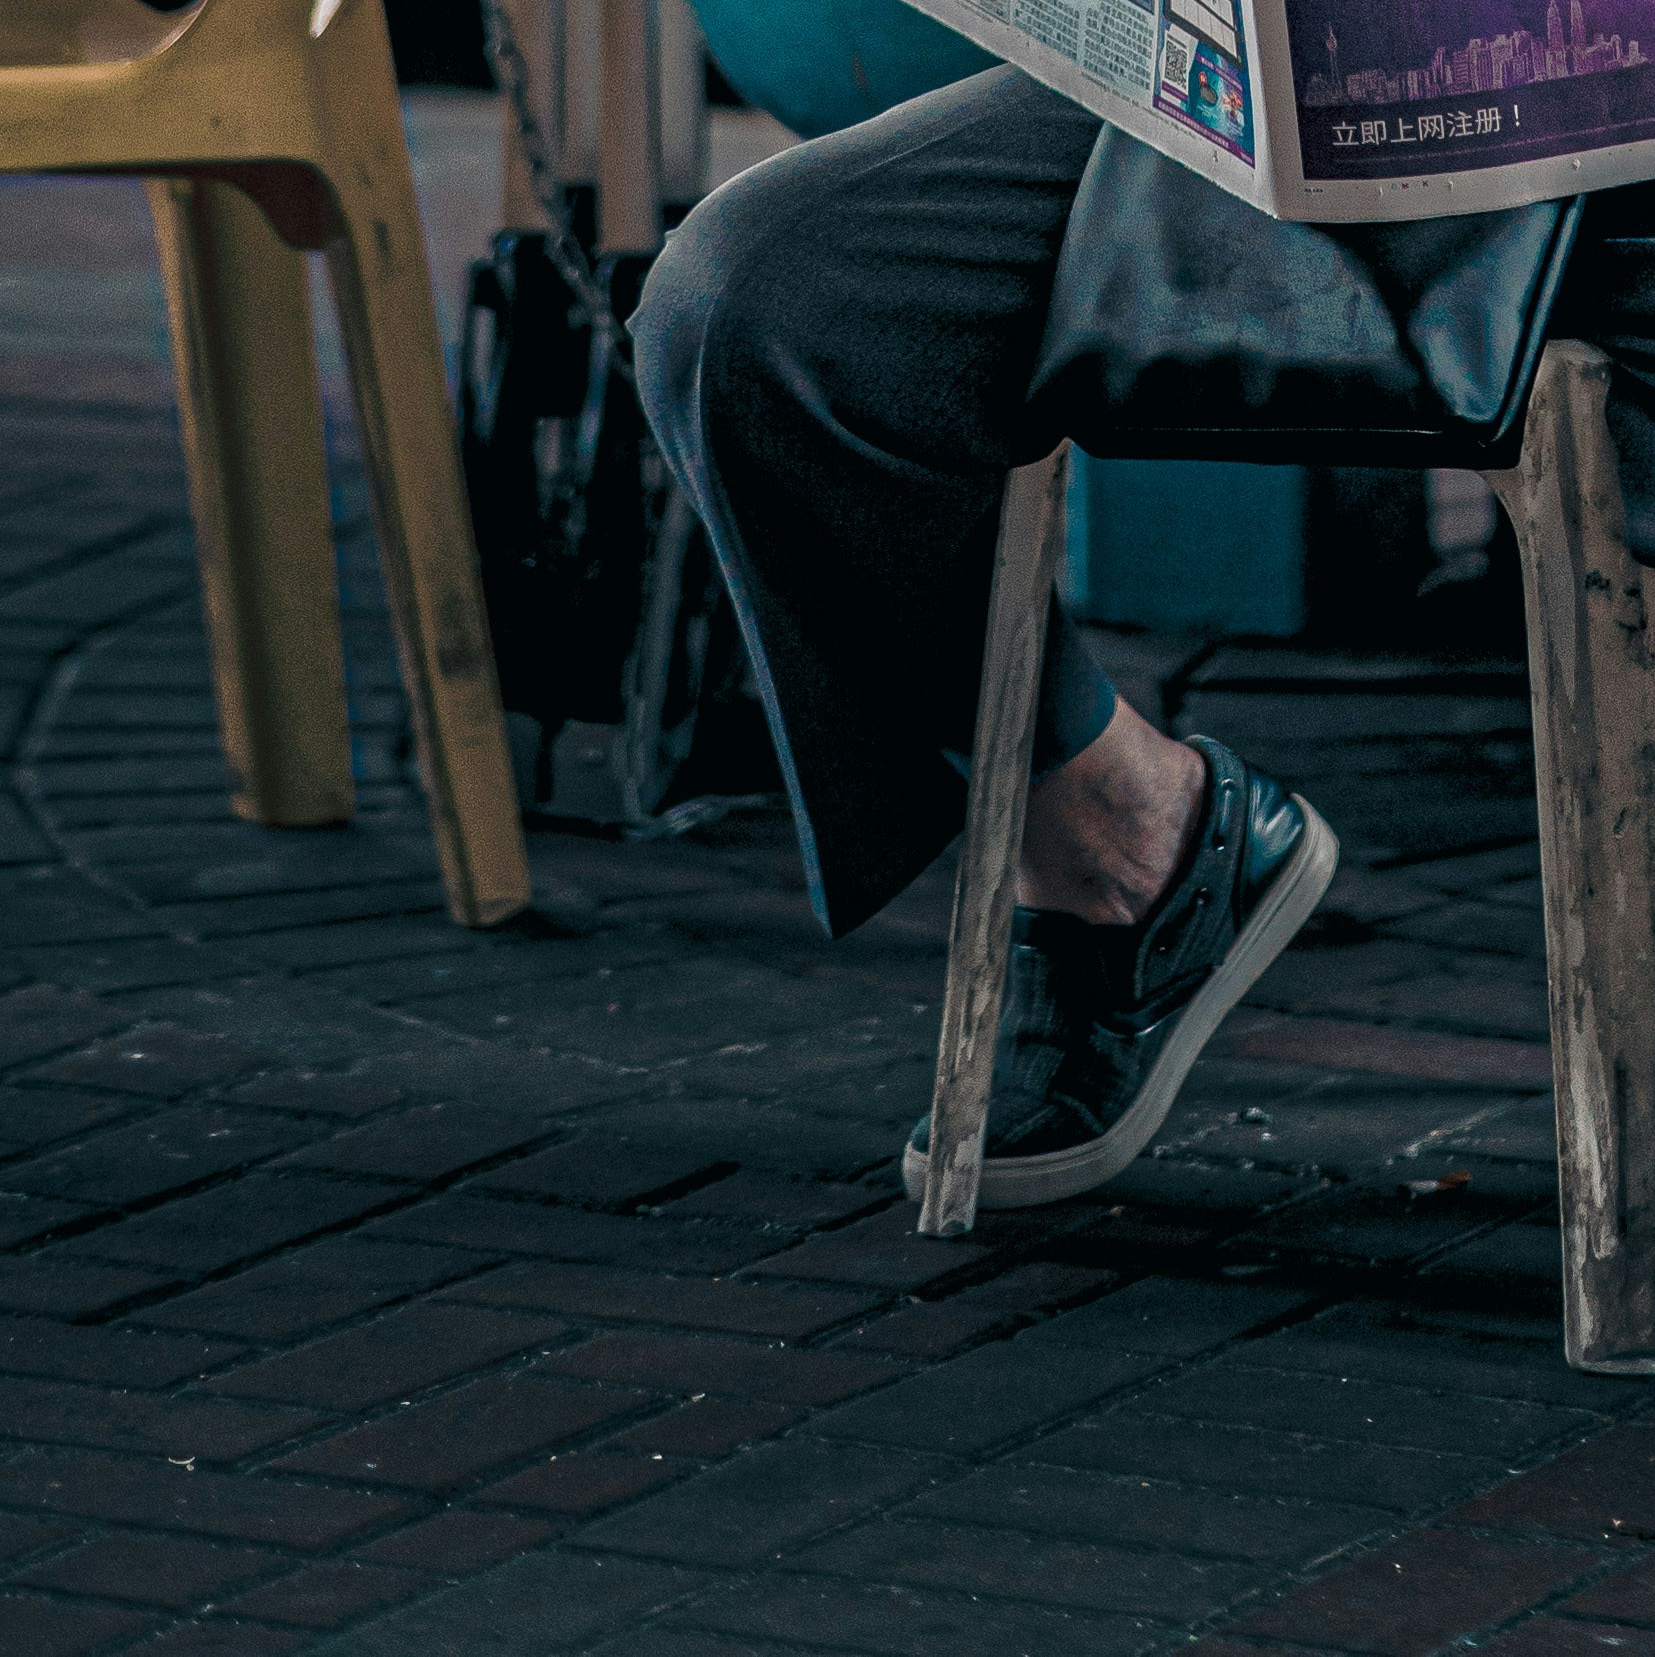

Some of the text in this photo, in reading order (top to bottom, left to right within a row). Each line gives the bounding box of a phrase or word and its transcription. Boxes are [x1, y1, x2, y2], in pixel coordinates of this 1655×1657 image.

[1332, 103, 1521, 146] 立即上网注册！
